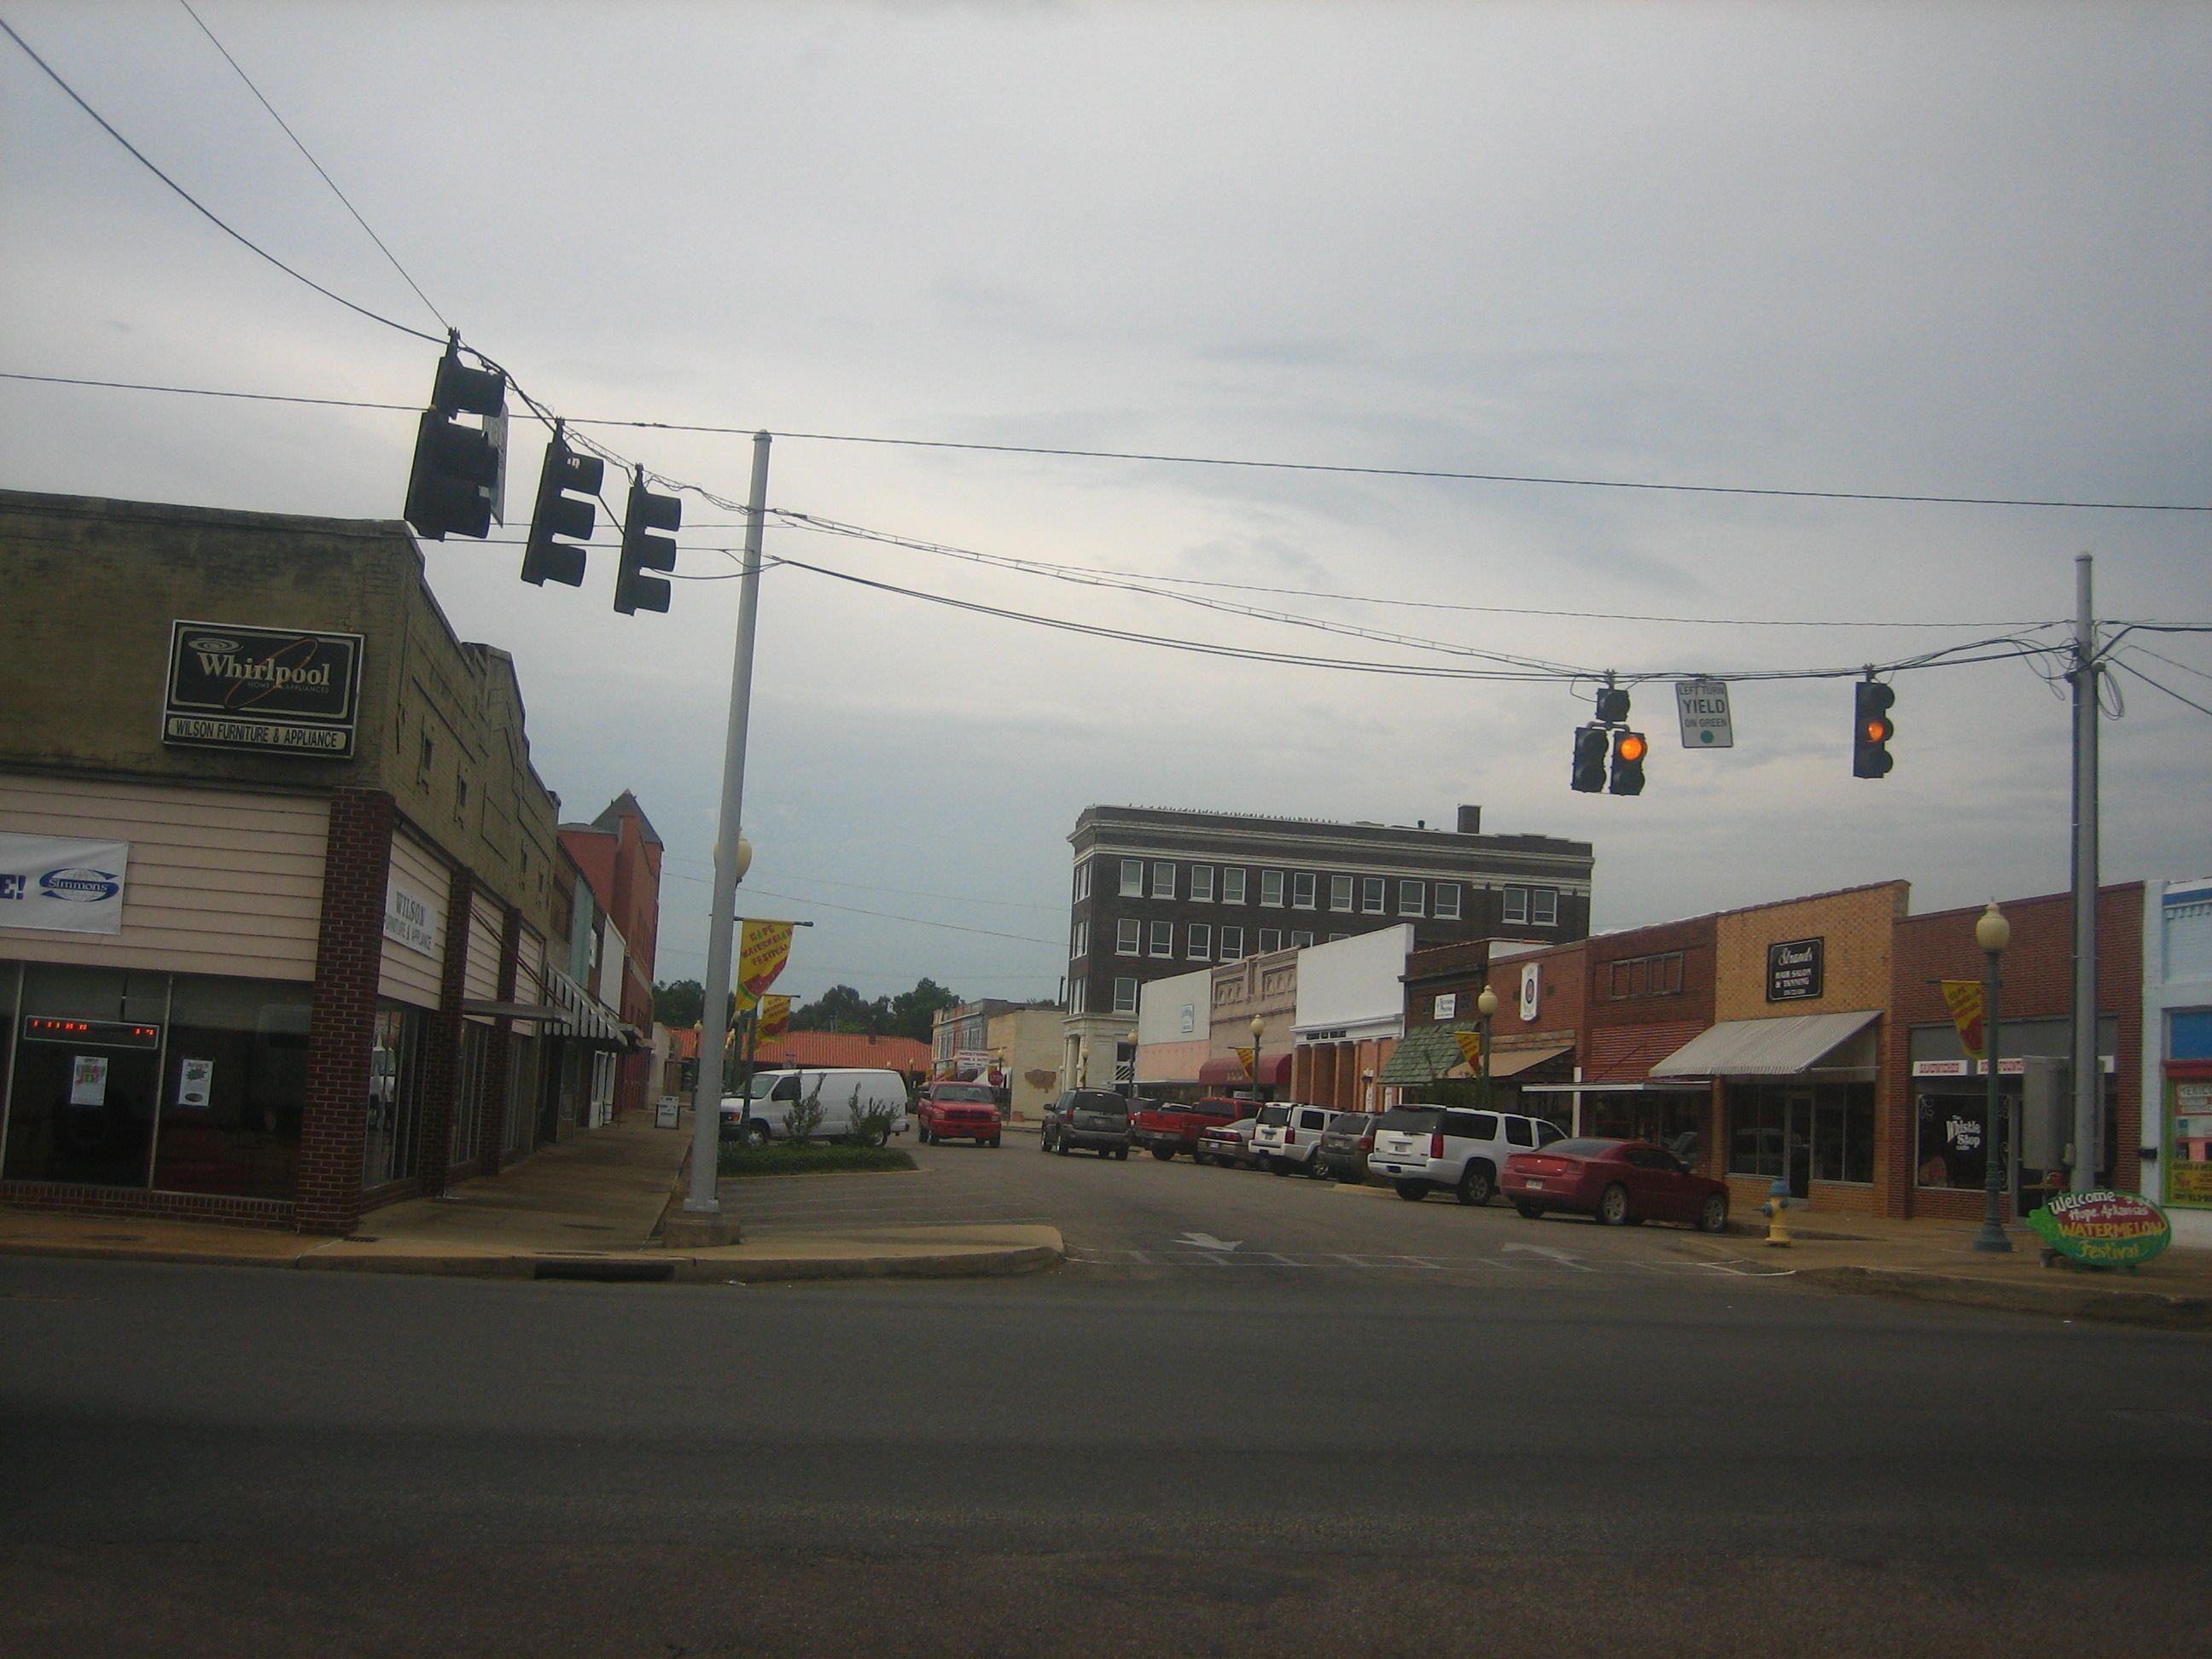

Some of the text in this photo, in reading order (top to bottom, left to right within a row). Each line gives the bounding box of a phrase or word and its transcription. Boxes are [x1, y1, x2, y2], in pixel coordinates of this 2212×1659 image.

[197, 652, 330, 687] Whirlpool
[1683, 700, 1726, 713] YIELD
[177, 720, 338, 748] WILSON FURNITURE & APPLIANCE
[48, 877, 108, 893] Simmons
[396, 891, 425, 927] WILSON
[1946, 1121, 1981, 1143] Whistle
[1956, 1135, 1980, 1148] Stop
[2048, 1191, 2116, 1215] Welcome
[2101, 1204, 2148, 1219] Arkansas
[2058, 1221, 2165, 1237] WATERMELON
[2080, 1240, 2139, 1259] Festival
